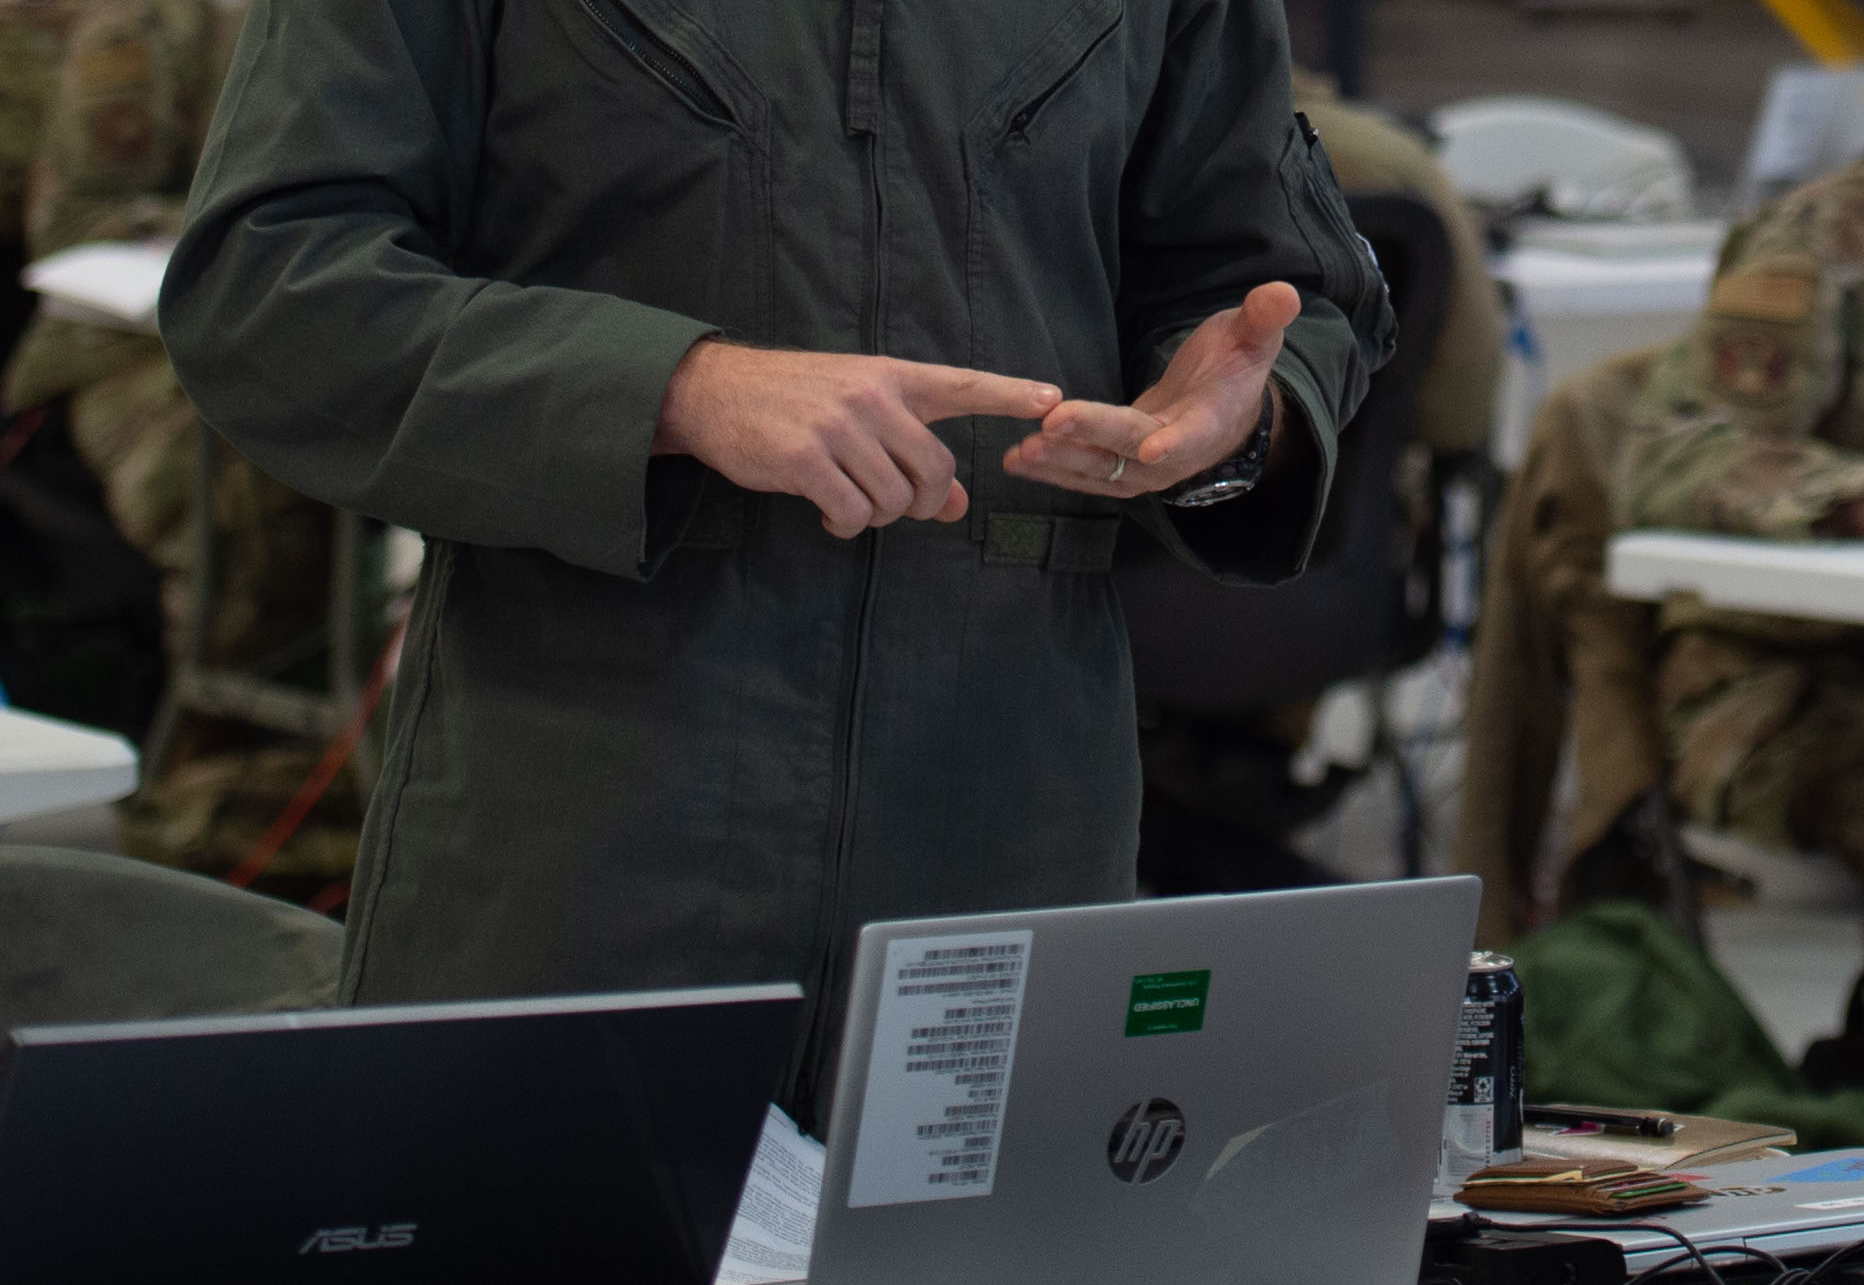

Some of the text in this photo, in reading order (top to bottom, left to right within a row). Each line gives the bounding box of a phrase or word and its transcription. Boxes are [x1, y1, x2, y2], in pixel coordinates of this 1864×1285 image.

[1133, 997, 1200, 1012] UNCLASSIFIED
[1110, 1097, 1185, 1184] hp
[298, 1223, 418, 1255] ASUS
